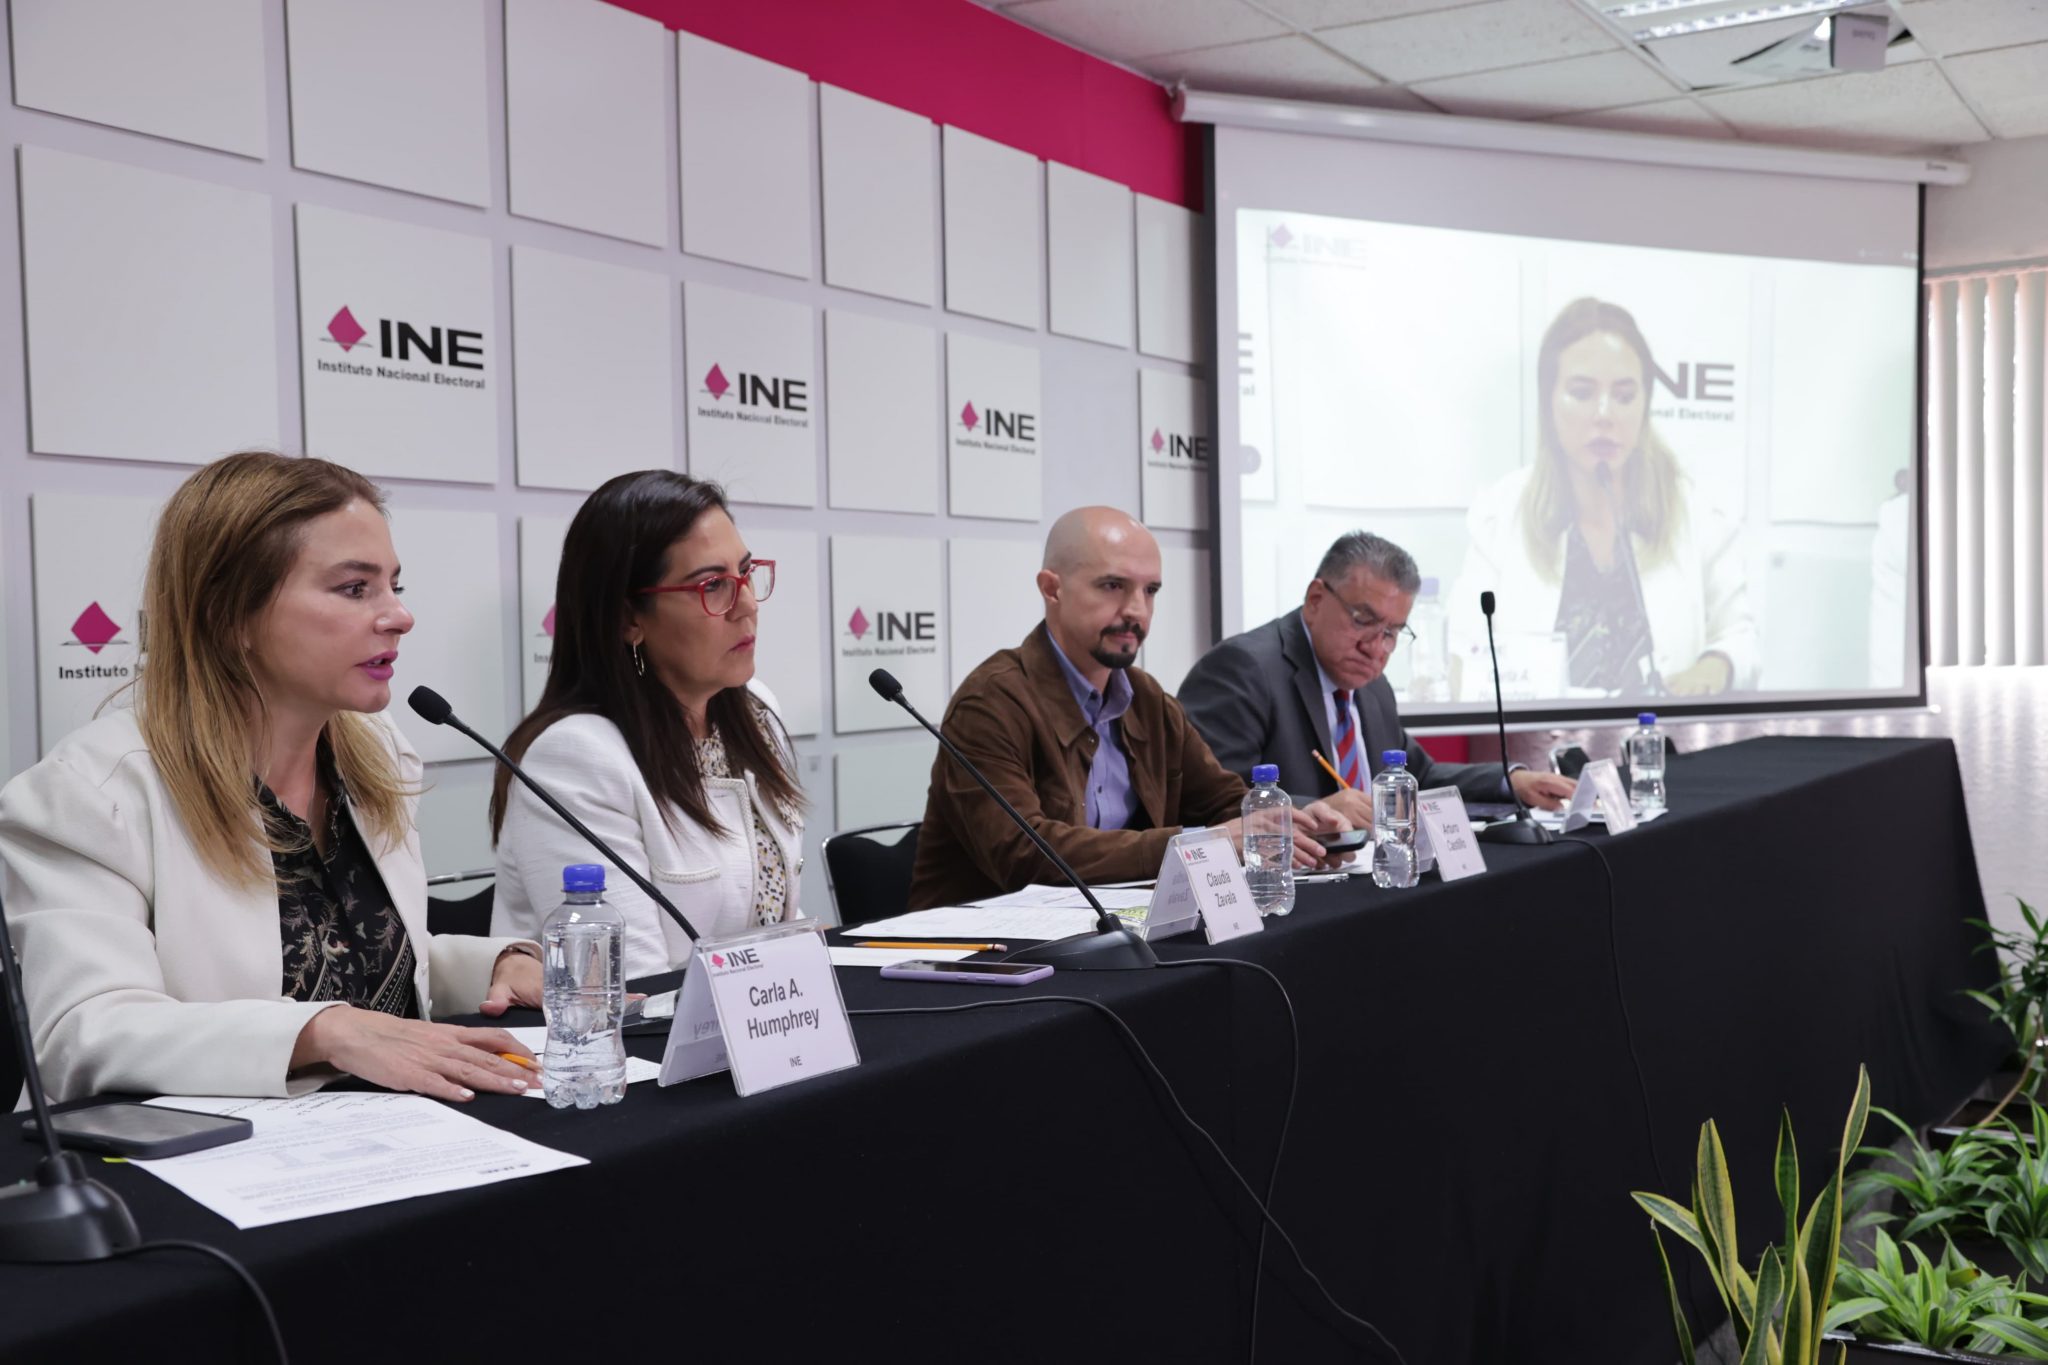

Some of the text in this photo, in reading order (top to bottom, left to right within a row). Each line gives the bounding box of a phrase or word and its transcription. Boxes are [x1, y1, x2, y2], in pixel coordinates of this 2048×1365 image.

[379, 318, 485, 370] INE
[318, 359, 485, 389] Instituto Nacional Electoral
[1649, 362, 1734, 401] NE
[739, 372, 807, 412] INE
[985, 408, 1035, 442] INE
[1170, 433, 1208, 460] INE
[877, 612, 935, 641] INE
[58, 665, 129, 679] Instituto
[1190, 847, 1207, 860] INE
[1206, 869, 1232, 887] Claudia
[1214, 891, 1238, 908] Zavala
[726, 948, 760, 968] INE
[748, 978, 804, 1007] Carla A.
[747, 1008, 820, 1040] Humphrey
[789, 1055, 803, 1068] INE
